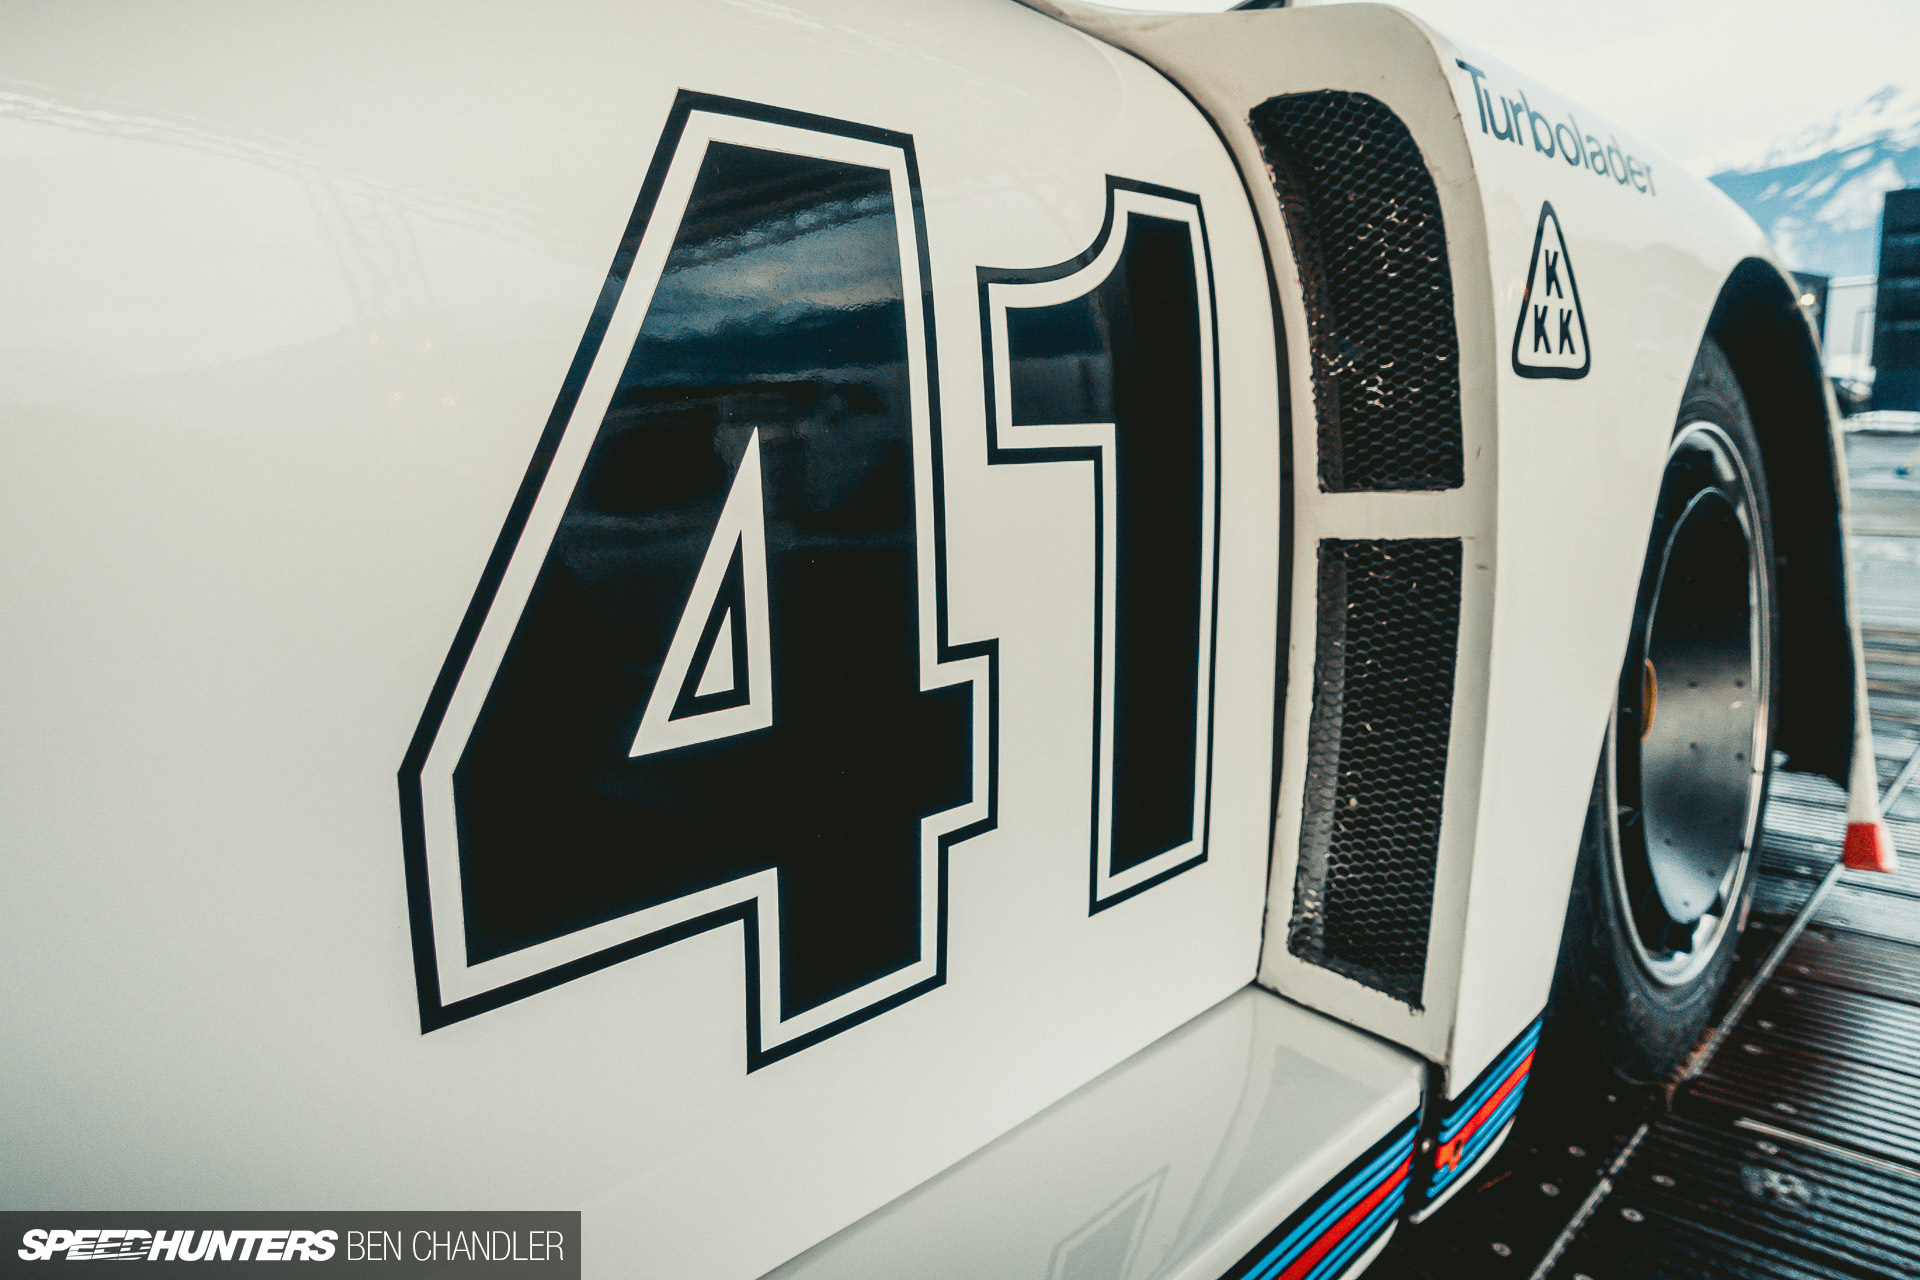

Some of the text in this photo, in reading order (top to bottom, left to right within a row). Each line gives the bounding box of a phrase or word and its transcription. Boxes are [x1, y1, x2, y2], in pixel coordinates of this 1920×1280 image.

[1455, 58, 1657, 198] Turbolader
[1544, 249, 1564, 300] K
[397, 87, 1222, 1075] 41
